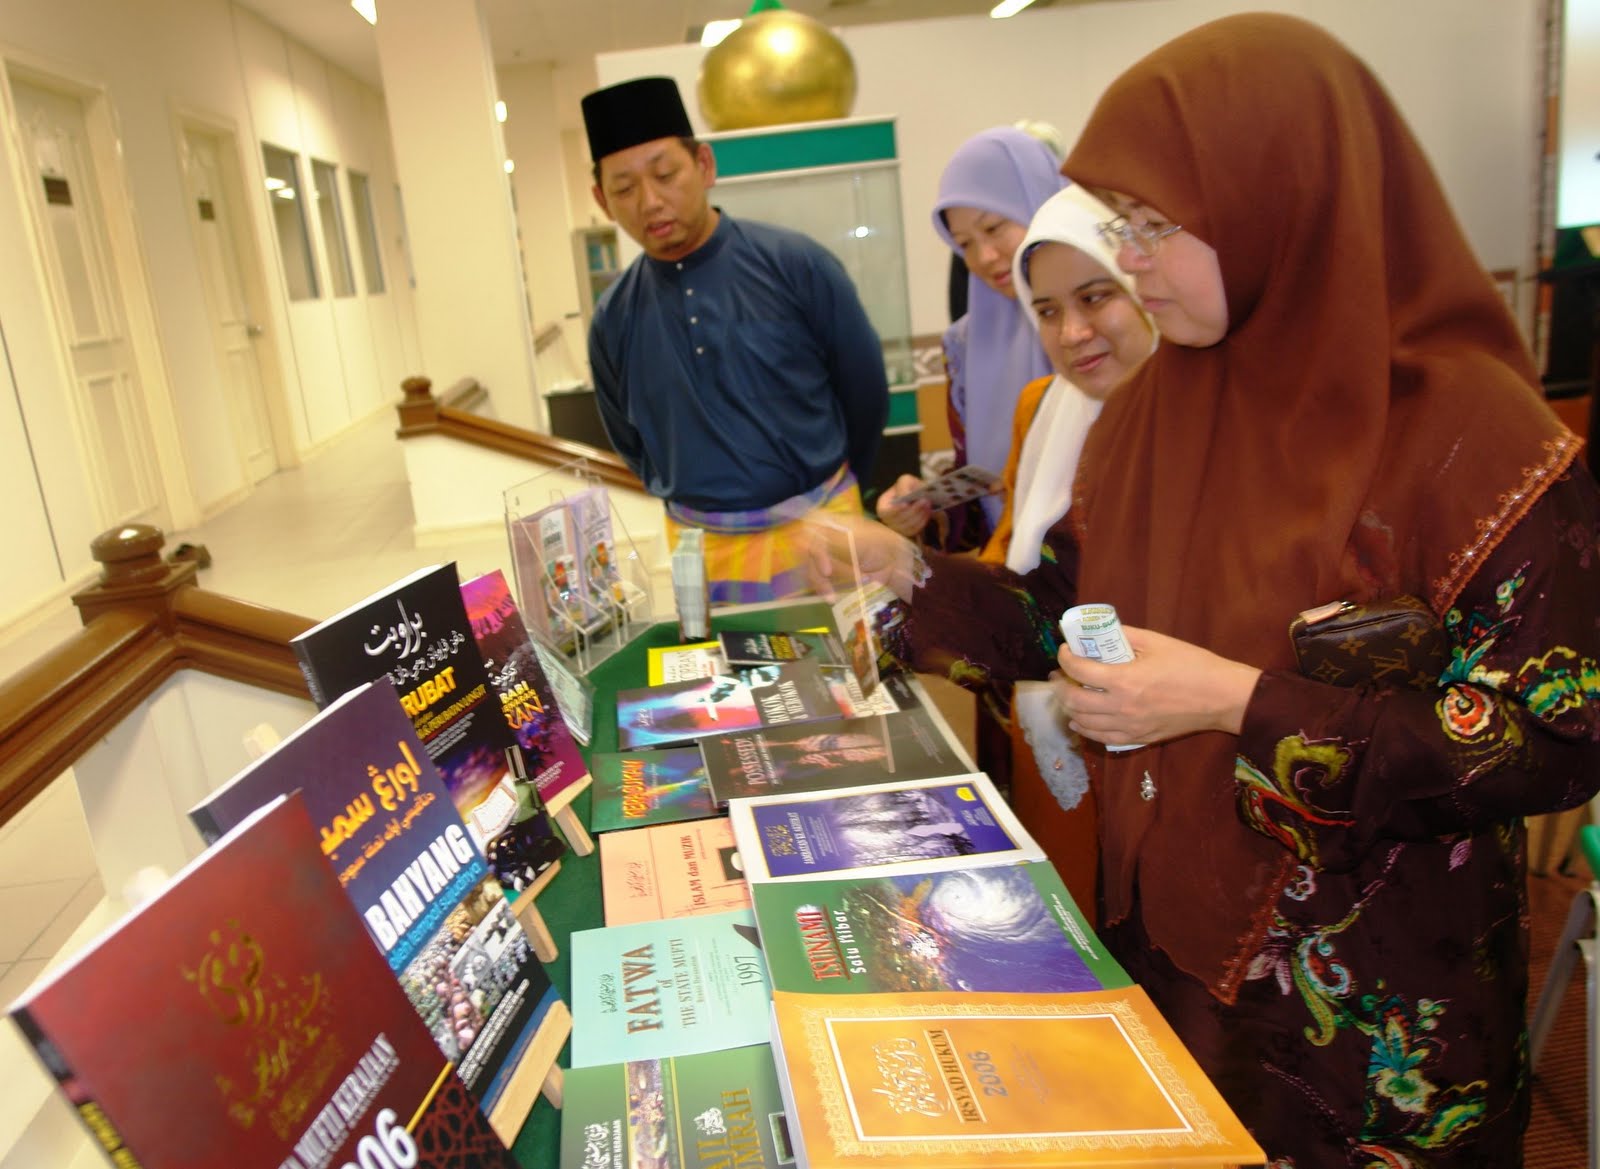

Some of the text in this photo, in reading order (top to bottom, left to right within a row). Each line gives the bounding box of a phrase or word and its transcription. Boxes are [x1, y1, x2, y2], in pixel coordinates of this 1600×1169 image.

[400, 665, 457, 718] RUBAT
[761, 694, 790, 724] ROKOK
[680, 835, 696, 860] MUZIK
[364, 824, 475, 951] BAHYANG
[687, 861, 700, 877] dan
[689, 879, 706, 906] ISLAM
[795, 912, 843, 981] TSUNAMI
[846, 947, 867, 974] Satu
[621, 943, 664, 1035] FATWA
[656, 978, 673, 989] of
[669, 938, 697, 1029] THE STATE MUFTI
[733, 955, 764, 987] 1997
[929, 1030, 980, 1123] IRSYAD HUKUM
[968, 1051, 1008, 1097] 2006
